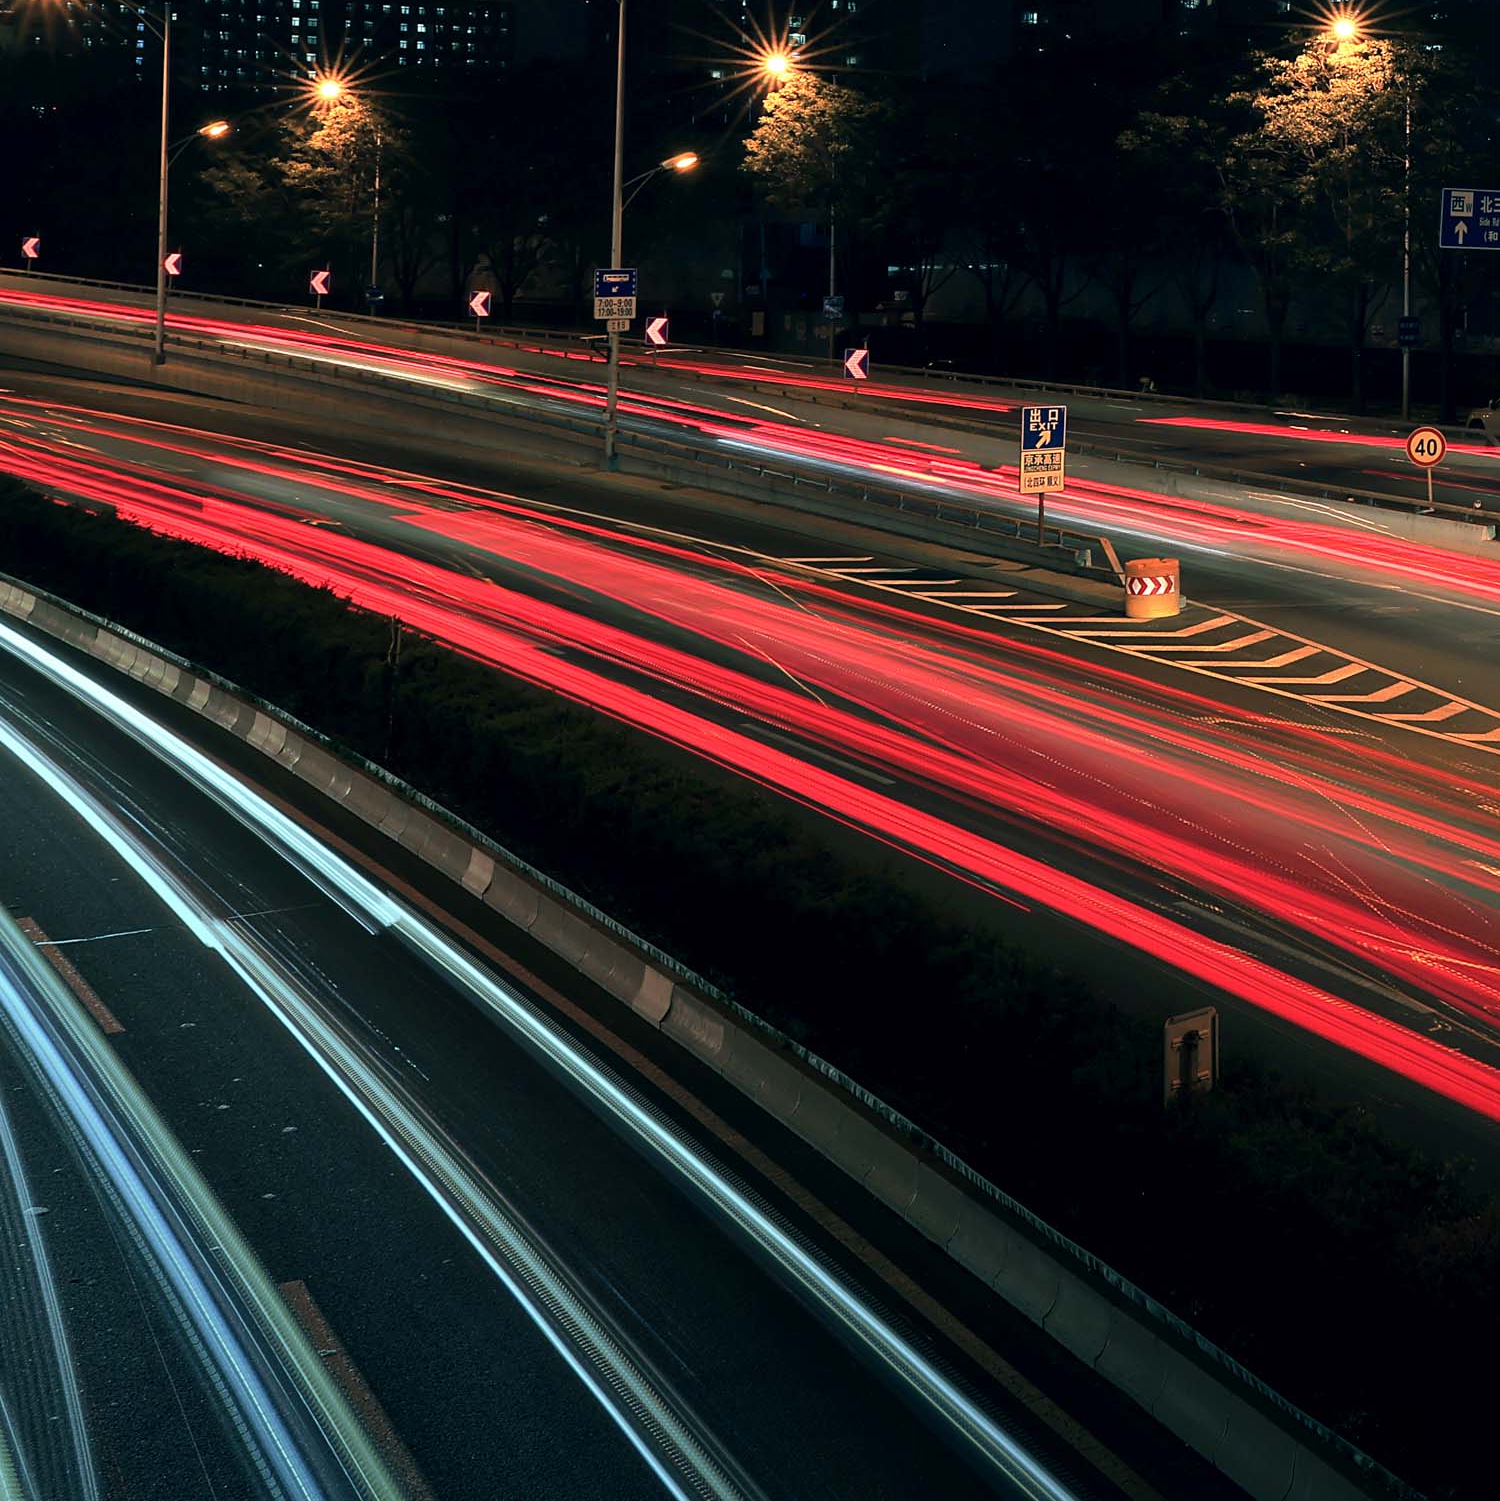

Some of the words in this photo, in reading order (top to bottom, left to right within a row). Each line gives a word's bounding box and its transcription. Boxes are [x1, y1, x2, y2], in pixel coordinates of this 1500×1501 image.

[1030, 408, 1059, 423] 出口
[1029, 422, 1059, 432] EXIT
[1415, 438, 1437, 456] 40
